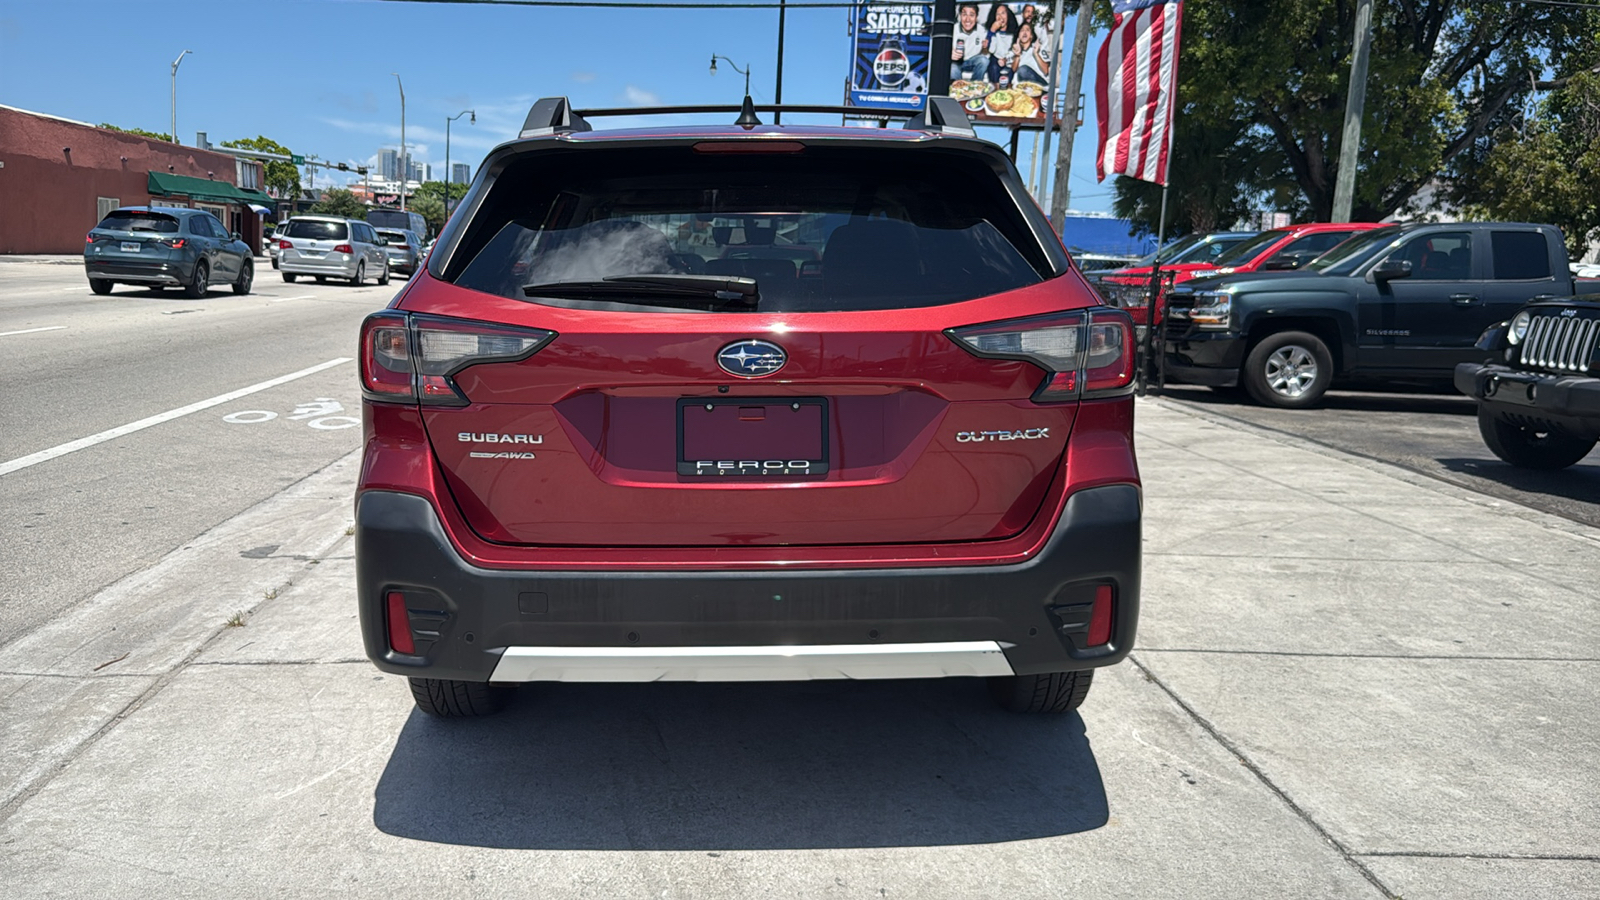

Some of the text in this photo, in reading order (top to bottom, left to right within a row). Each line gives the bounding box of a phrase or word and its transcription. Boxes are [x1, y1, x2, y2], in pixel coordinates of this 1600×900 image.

[910, 6, 924, 14] DEL
[866, 13, 924, 36] SABOR
[876, 62, 907, 72] PEPSI
[458, 432, 543, 444] SUBARU
[956, 427, 1050, 443] OUTBACK
[696, 460, 810, 469] FERCO
